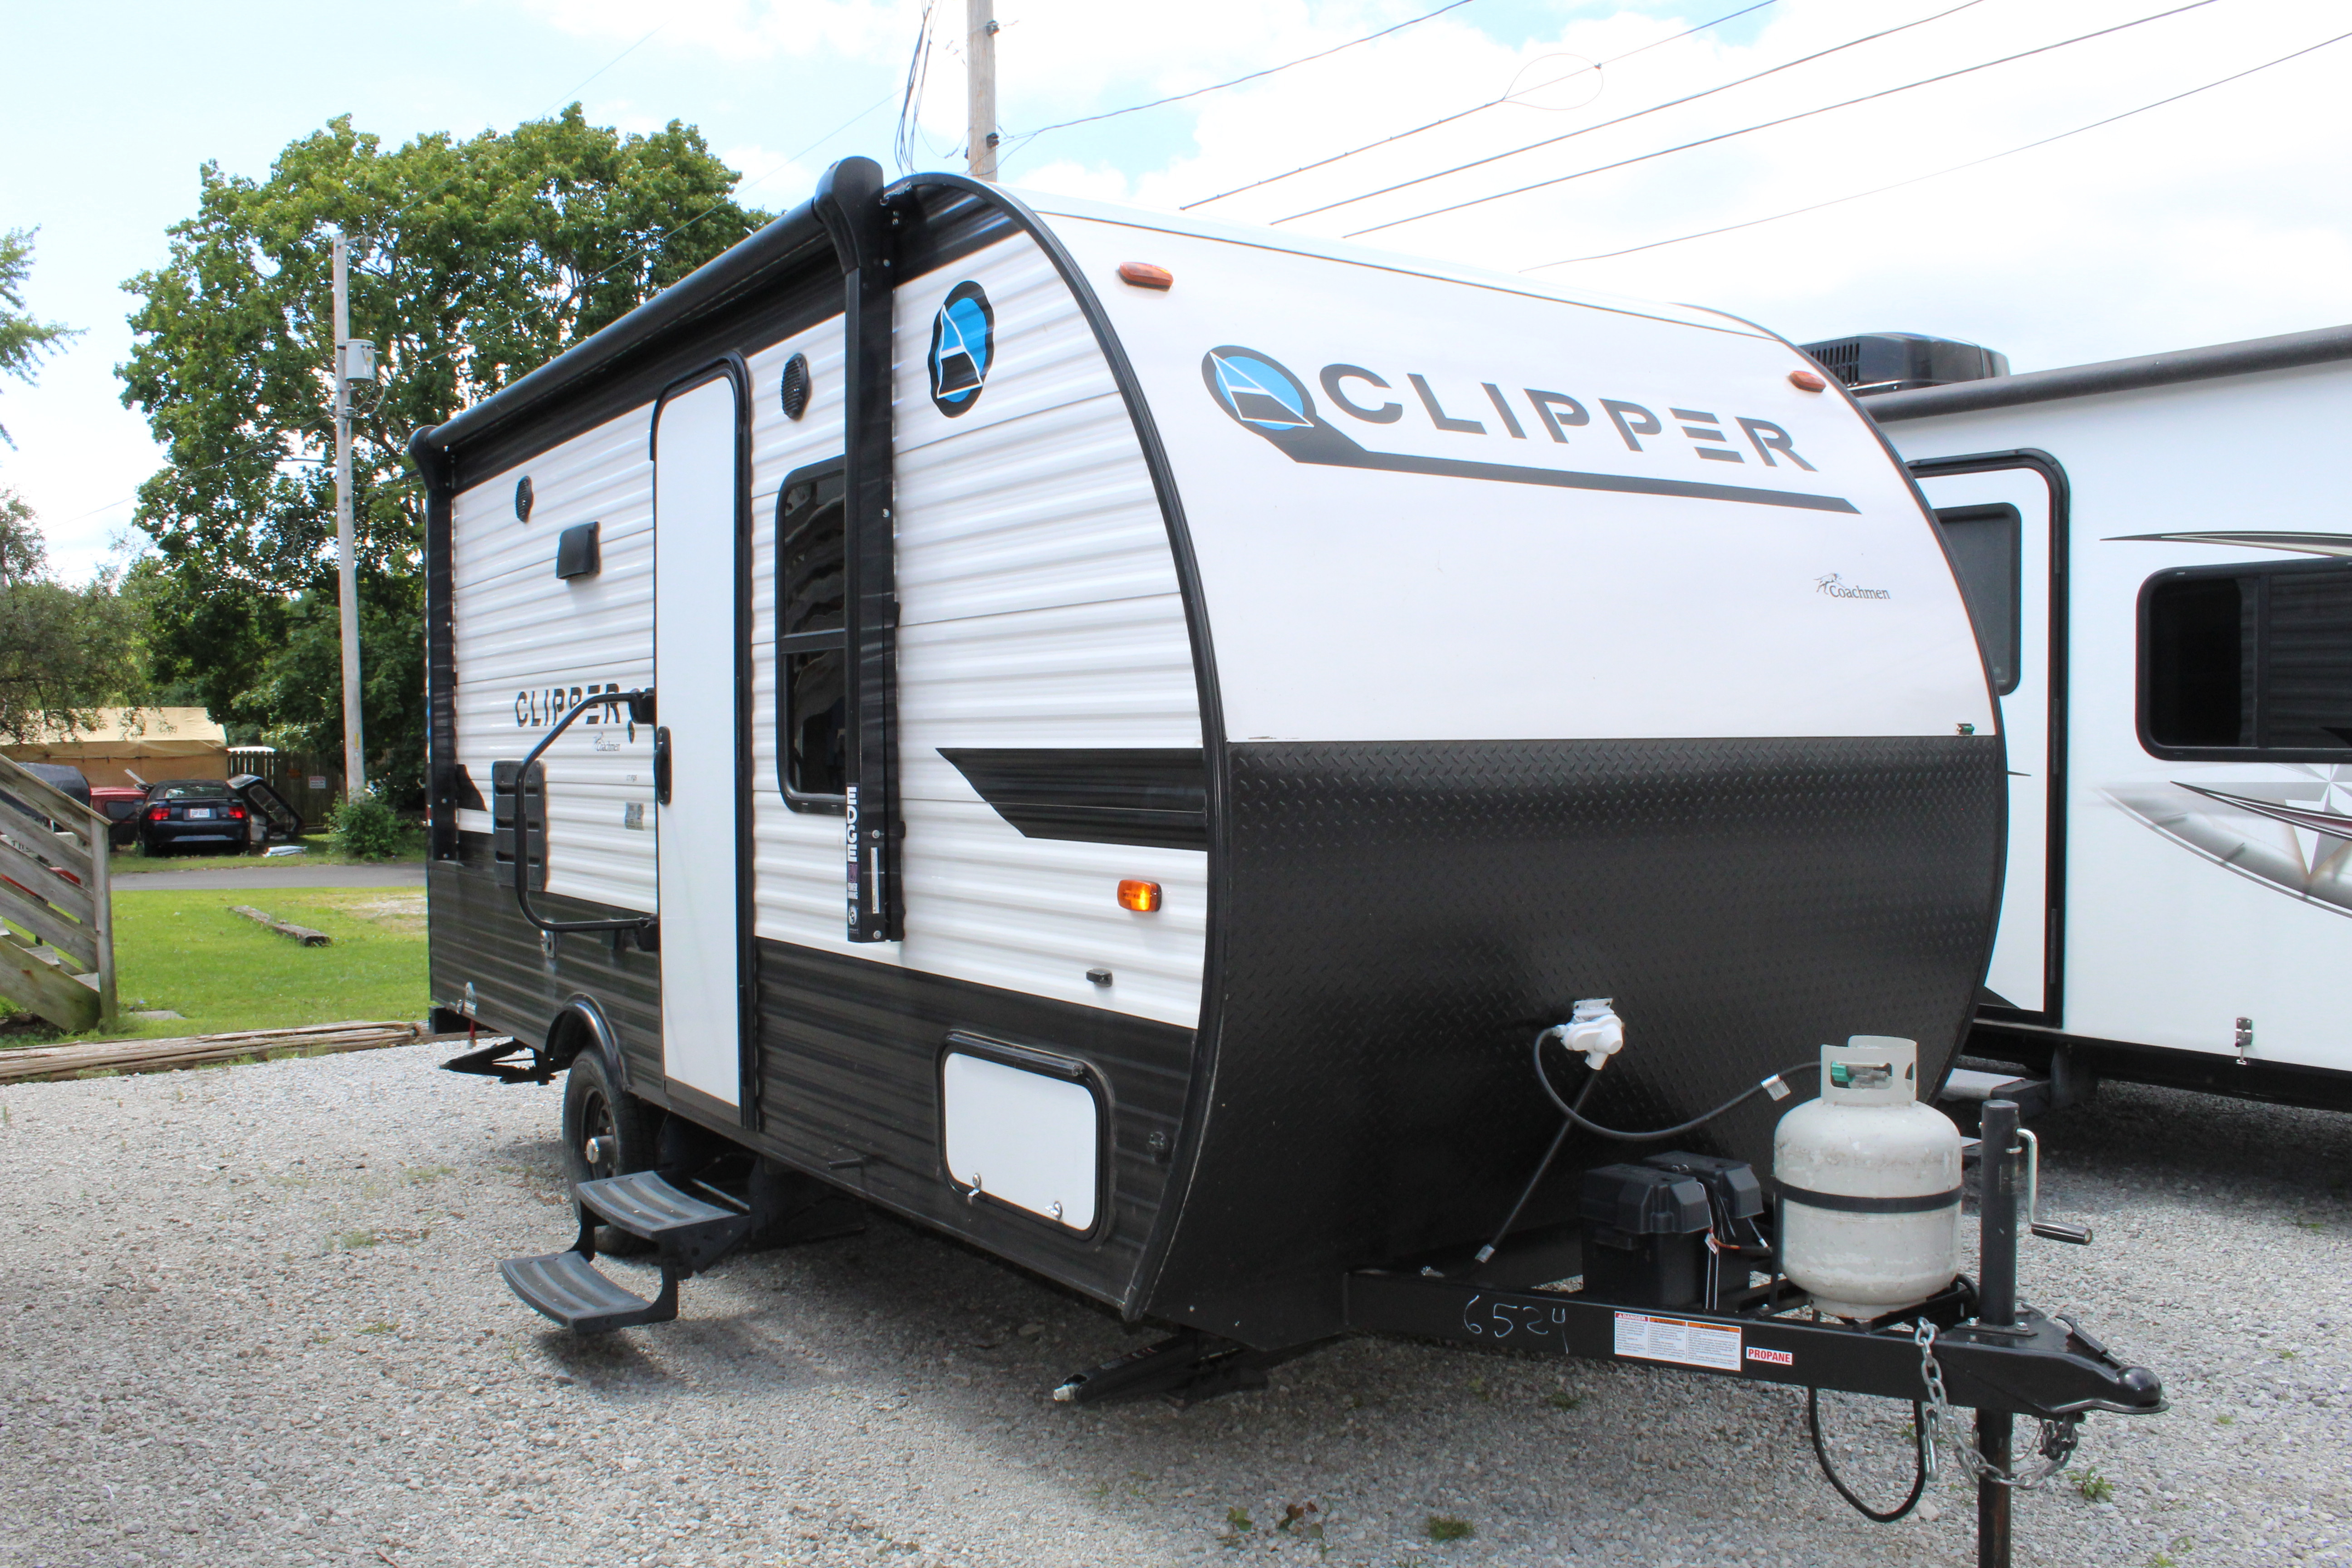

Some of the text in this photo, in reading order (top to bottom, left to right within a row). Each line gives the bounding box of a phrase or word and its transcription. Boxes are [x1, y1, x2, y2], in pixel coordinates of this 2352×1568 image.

[1319, 363, 1819, 472] CLIPPER
[1828, 585, 1891, 599] Coachmen
[847, 786, 858, 862] EDGE
[1463, 1295, 1568, 1354] 6524
[1748, 1348, 1791, 1363] PROPANE
